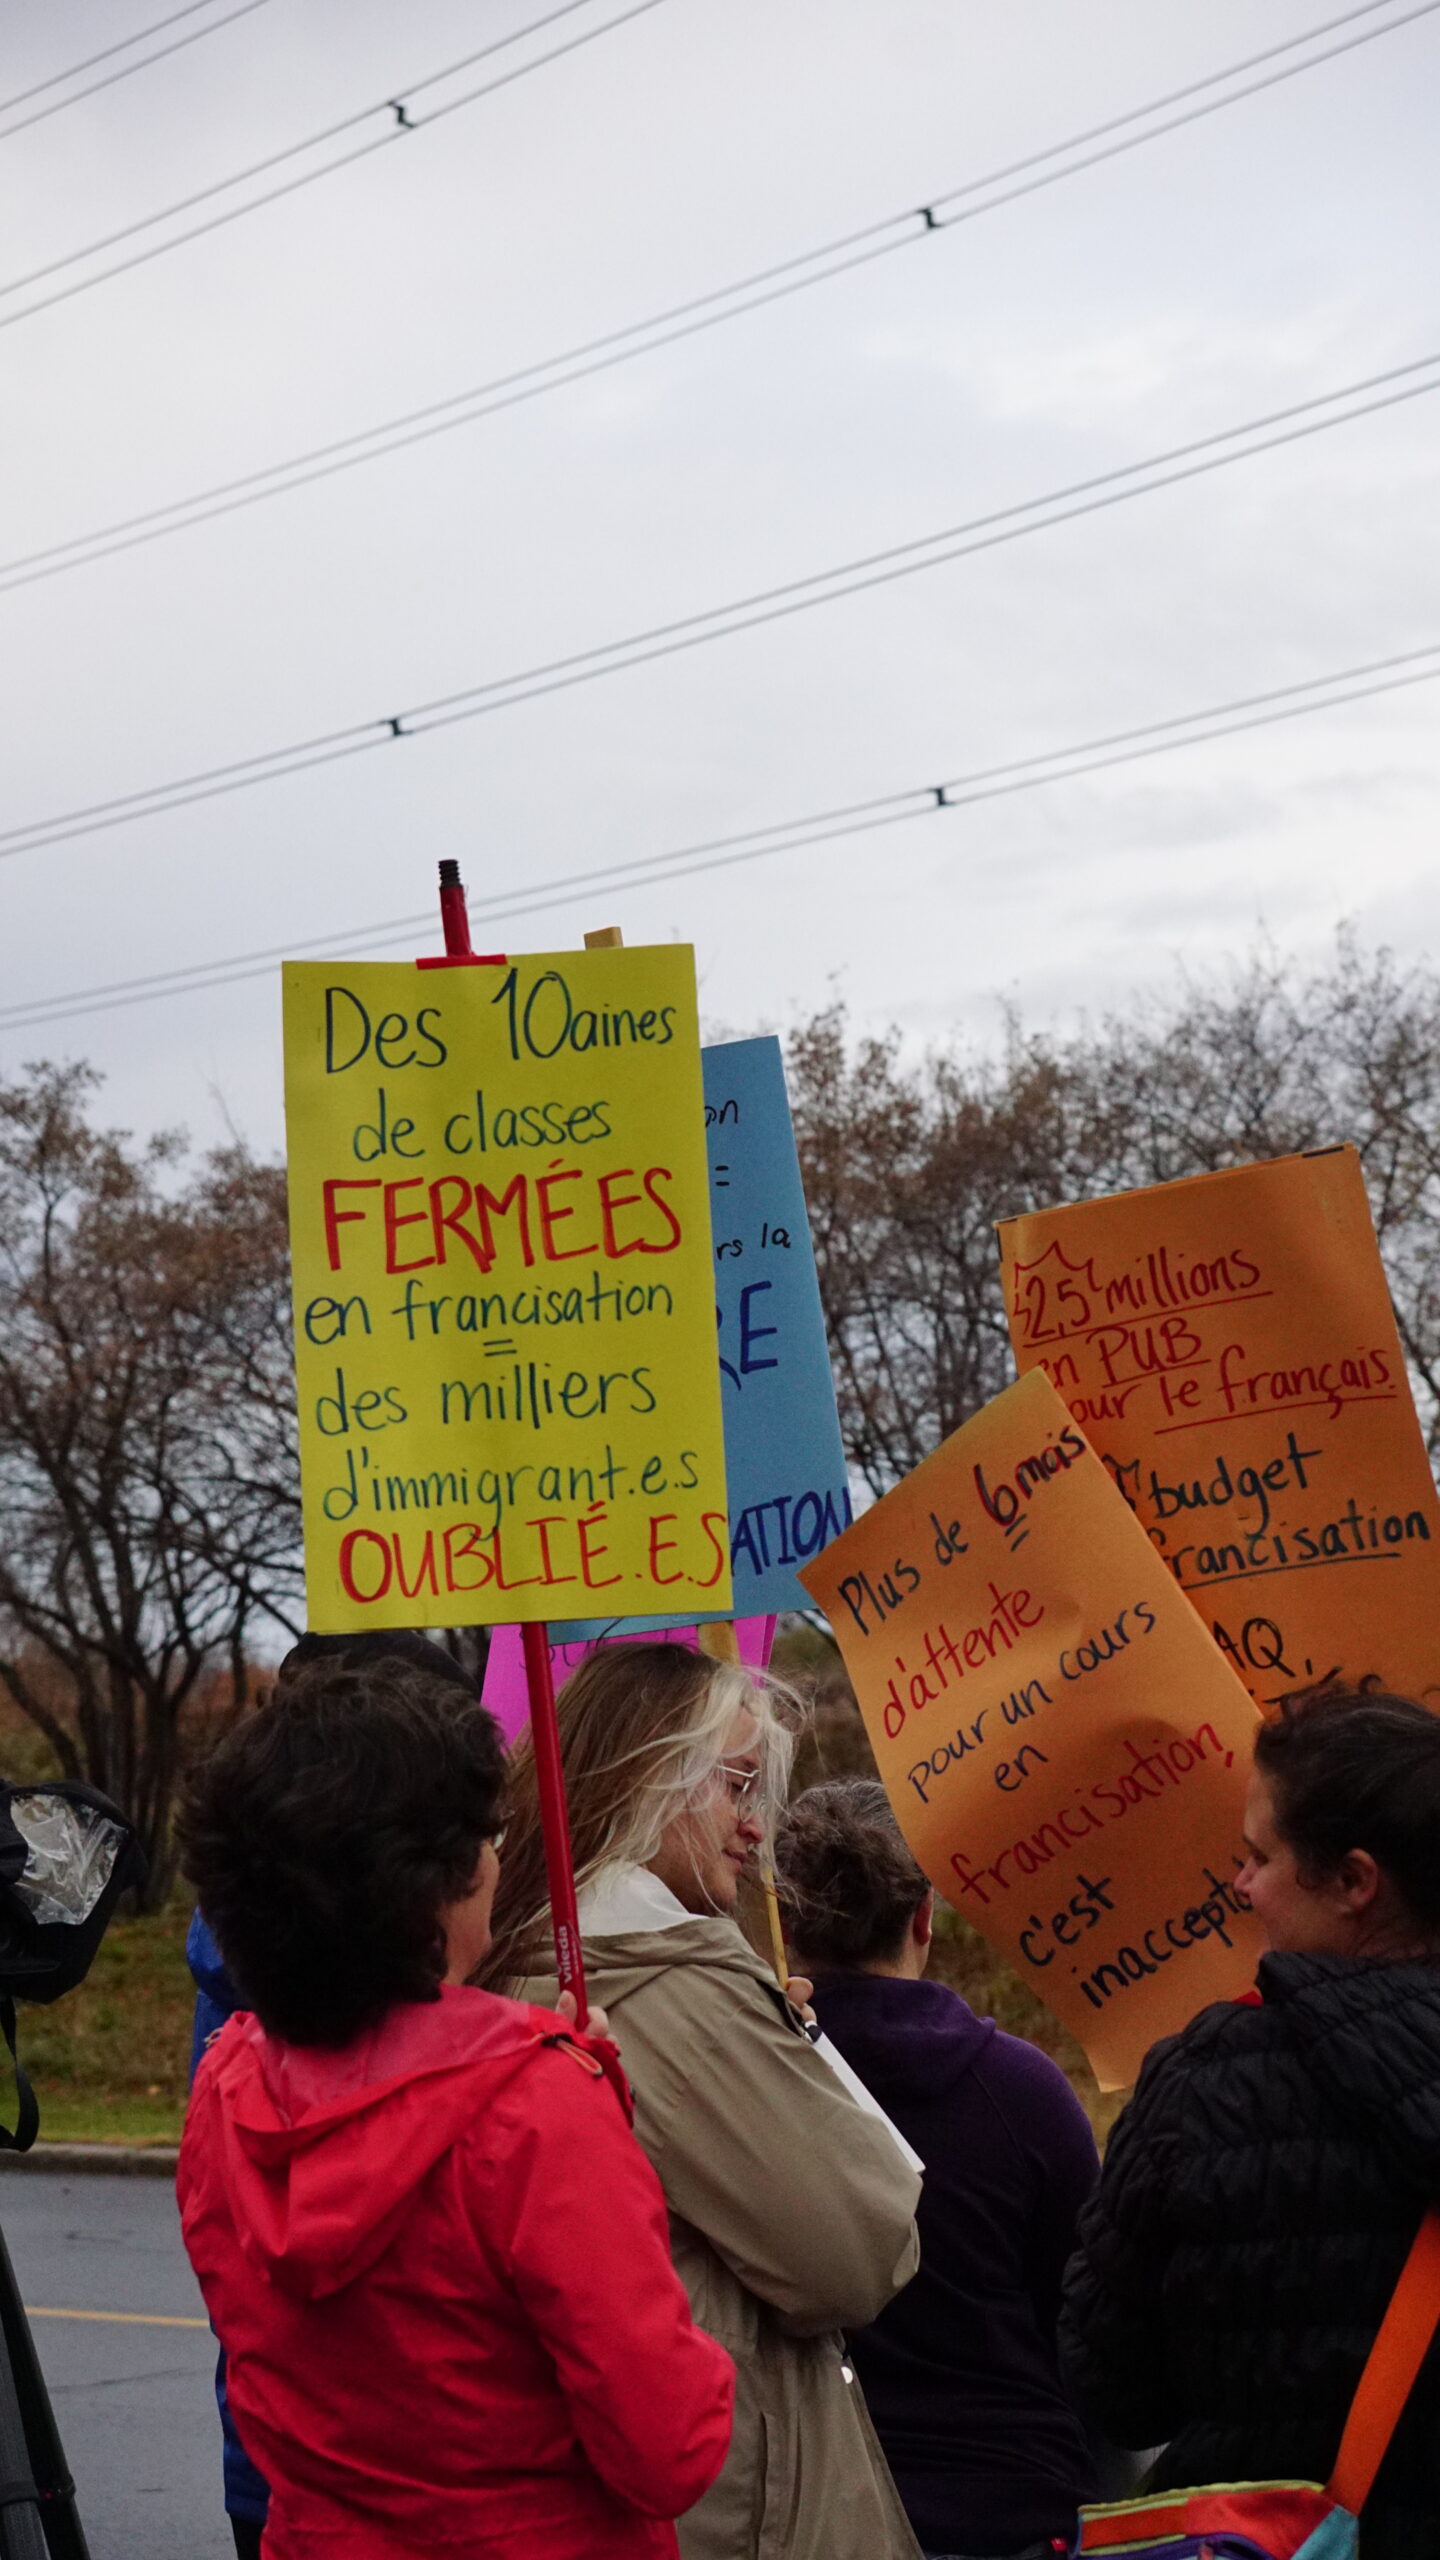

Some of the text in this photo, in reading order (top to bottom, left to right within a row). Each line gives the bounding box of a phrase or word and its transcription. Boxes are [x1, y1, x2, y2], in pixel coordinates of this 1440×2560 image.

[325, 967, 677, 1073] Des 10aines
[353, 1087, 611, 1162] de classes
[323, 1158, 682, 1274] FERMÉES
[761, 1223, 791, 1249] la
[304, 1271, 673, 1344] en francisation
[1106, 1246, 1260, 1314] millions
[316, 1362, 656, 1435] des milliers
[1068, 1383, 1142, 1424] our
[1161, 1375, 1200, 1418] le
[1085, 1317, 1200, 1385] PUB
[322, 1444, 699, 1541] d'immigrant.e.s
[1149, 1432, 1323, 1535] budget
[338, 1500, 727, 1604] OUBLIÉ.E.S
[838, 1558, 921, 1637] Plus
[929, 1512, 969, 1566] de
[973, 1464, 1019, 1526] 6
[882, 1581, 1045, 1738] d'attente
[907, 1601, 1157, 1803] pour un cours
[950, 1722, 1235, 1903] francisation,
[994, 1743, 1049, 1792] en
[1018, 1873, 1115, 1967] c'est
[1071, 1856, 1255, 2009] inaccepta
